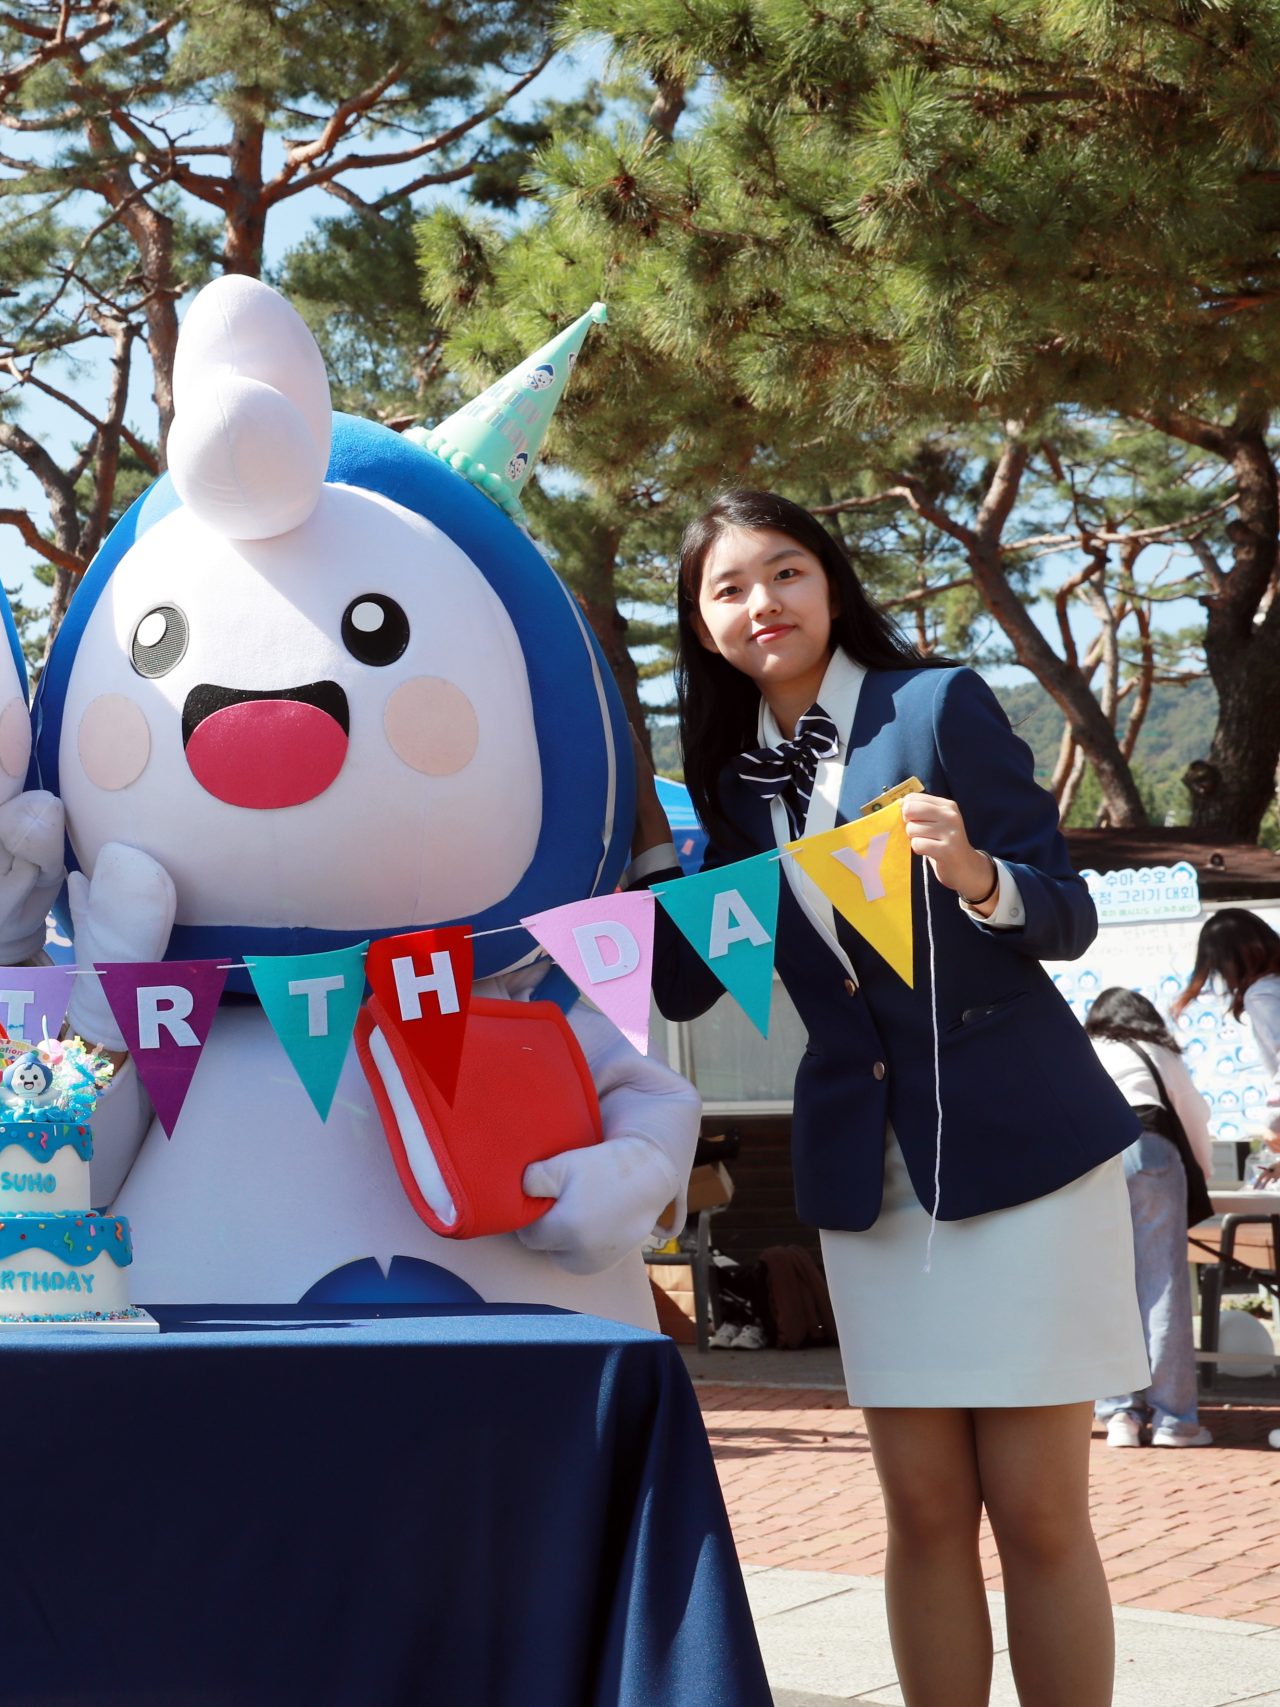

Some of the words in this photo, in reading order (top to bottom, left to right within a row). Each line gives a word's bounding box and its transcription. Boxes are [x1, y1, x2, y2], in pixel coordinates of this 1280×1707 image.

[1118, 888, 1160, 903] 그리기
[1165, 886, 1194, 900] 대회
[0, 1171, 57, 1193] SUHO
